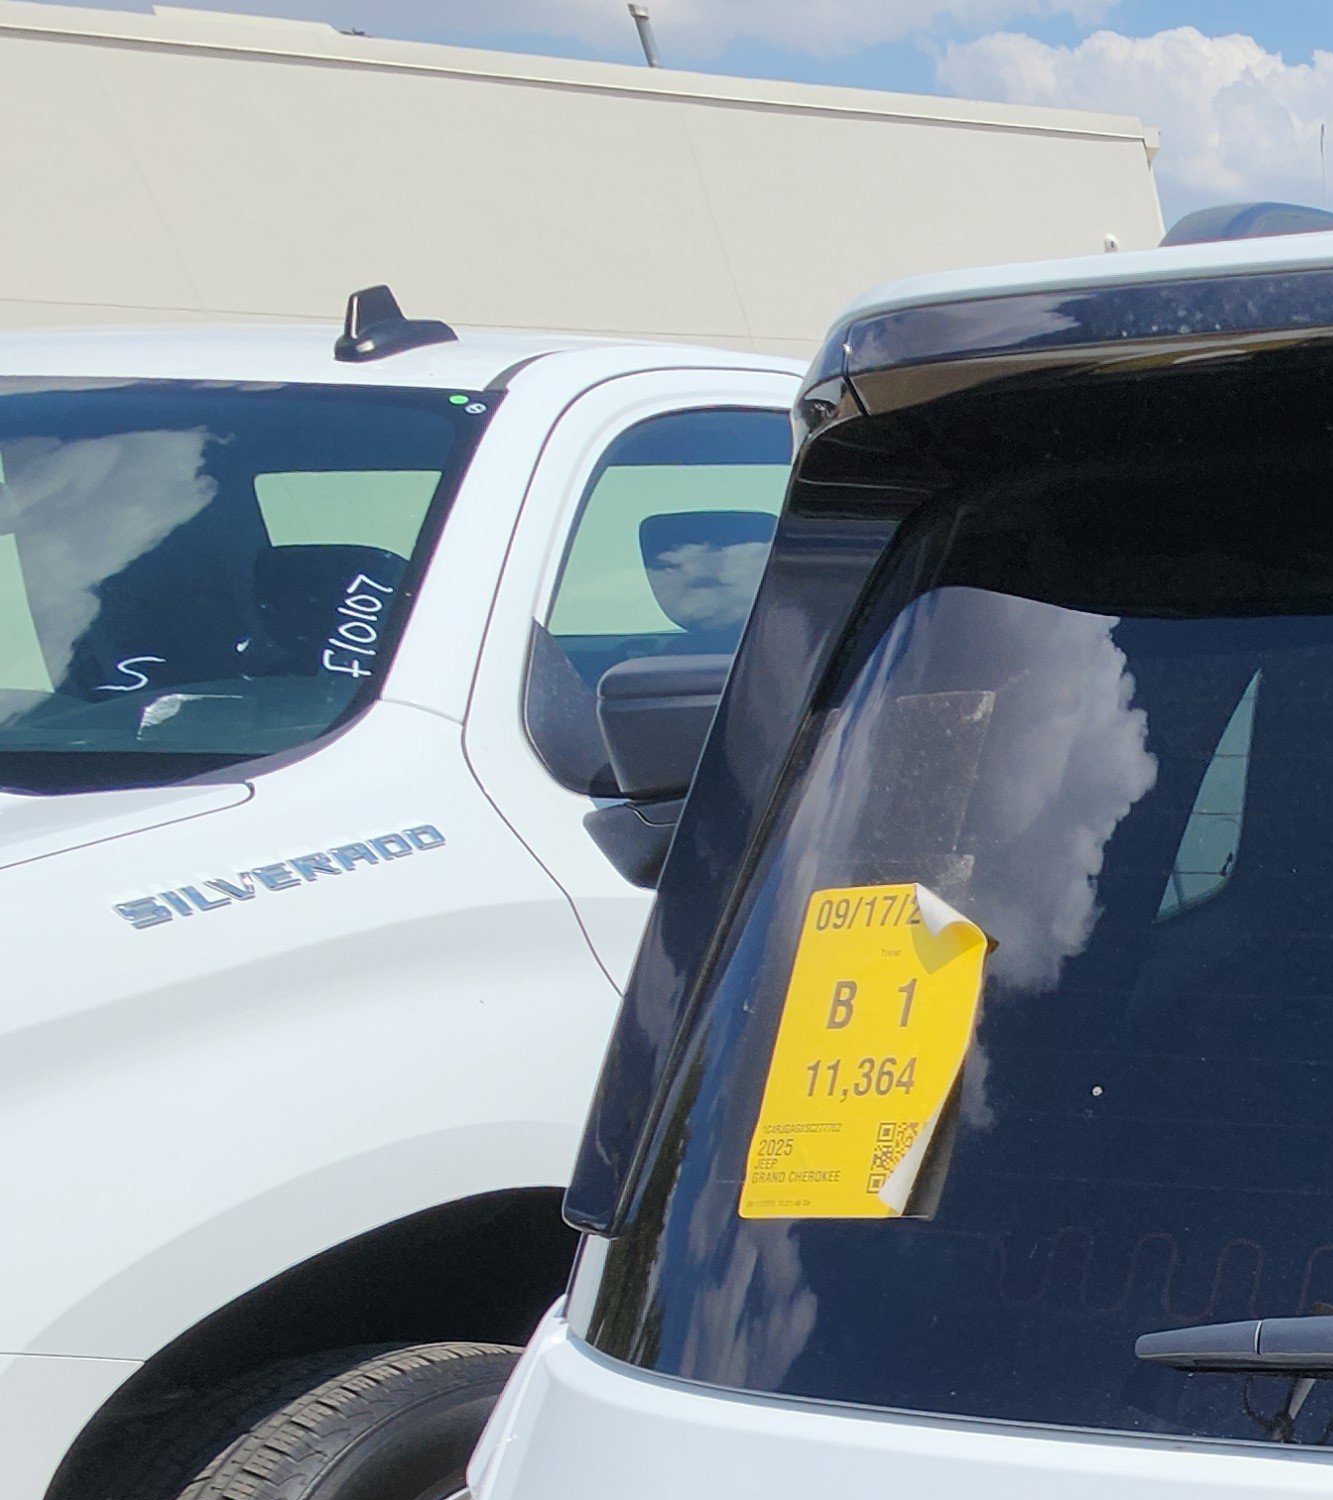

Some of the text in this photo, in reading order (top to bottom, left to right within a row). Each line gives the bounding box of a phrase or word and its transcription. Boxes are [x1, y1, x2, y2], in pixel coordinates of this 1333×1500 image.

[322, 574, 394, 678] F10107
[111, 824, 446, 930] SILVERADO
[816, 893, 921, 931] 09/17/2
[825, 978, 918, 1030] B 1
[806, 1057, 917, 1102] 11,364
[754, 1158, 778, 1170] JEEP
[757, 1138, 794, 1157] 2025
[751, 1170, 841, 1184] GRAND CHEROKEE
